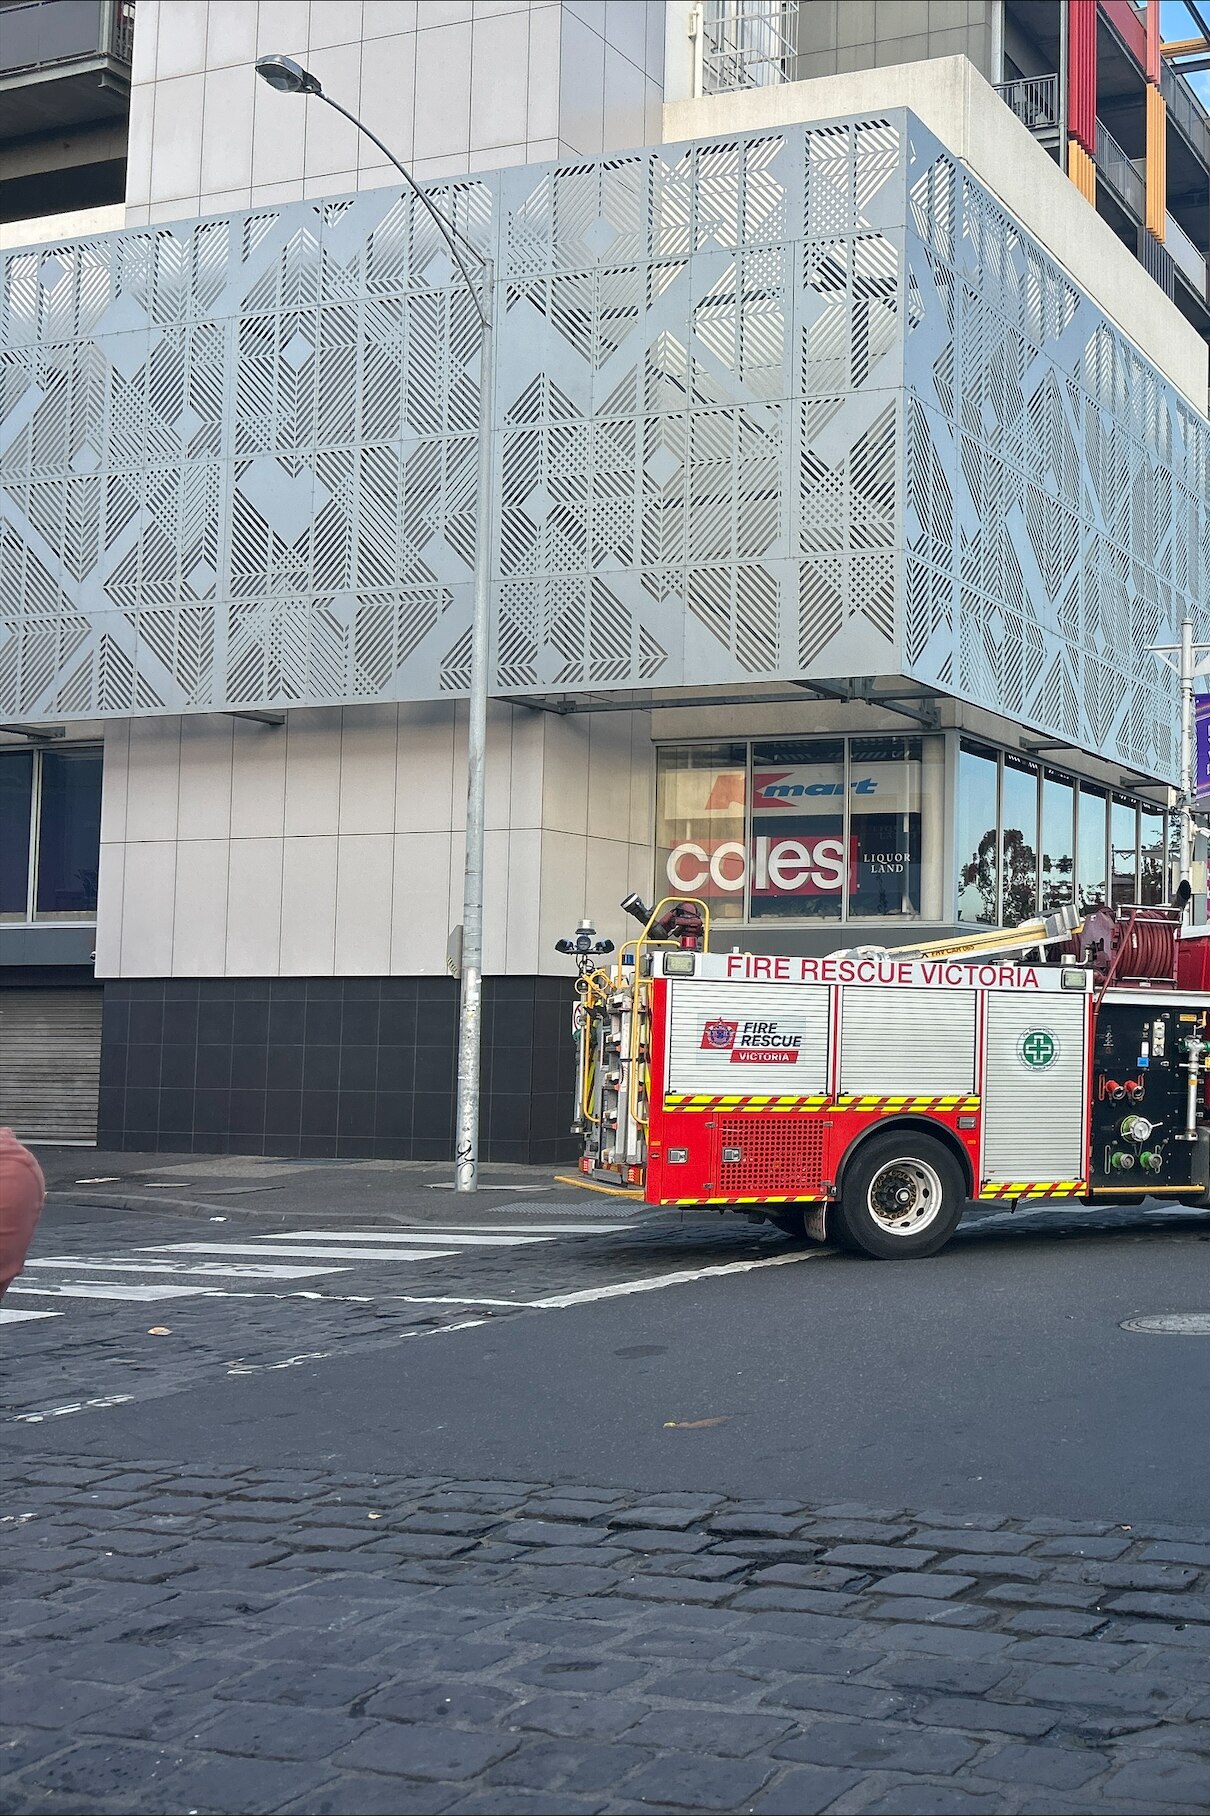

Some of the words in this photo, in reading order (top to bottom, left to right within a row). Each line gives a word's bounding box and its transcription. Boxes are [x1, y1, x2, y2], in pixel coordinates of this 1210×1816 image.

[704, 772, 879, 811] Kmart
[666, 836, 852, 892] coles
[863, 852, 911, 865] LIQUOR
[871, 864, 904, 874] LAND
[727, 956, 791, 980] FIRE
[801, 959, 913, 984] RESCUE
[921, 963, 1039, 989] VICTORIA
[743, 1022, 778, 1034] FIRE
[741, 1035, 802, 1047] RESCUE
[739, 1052, 789, 1061] VICTORIA
